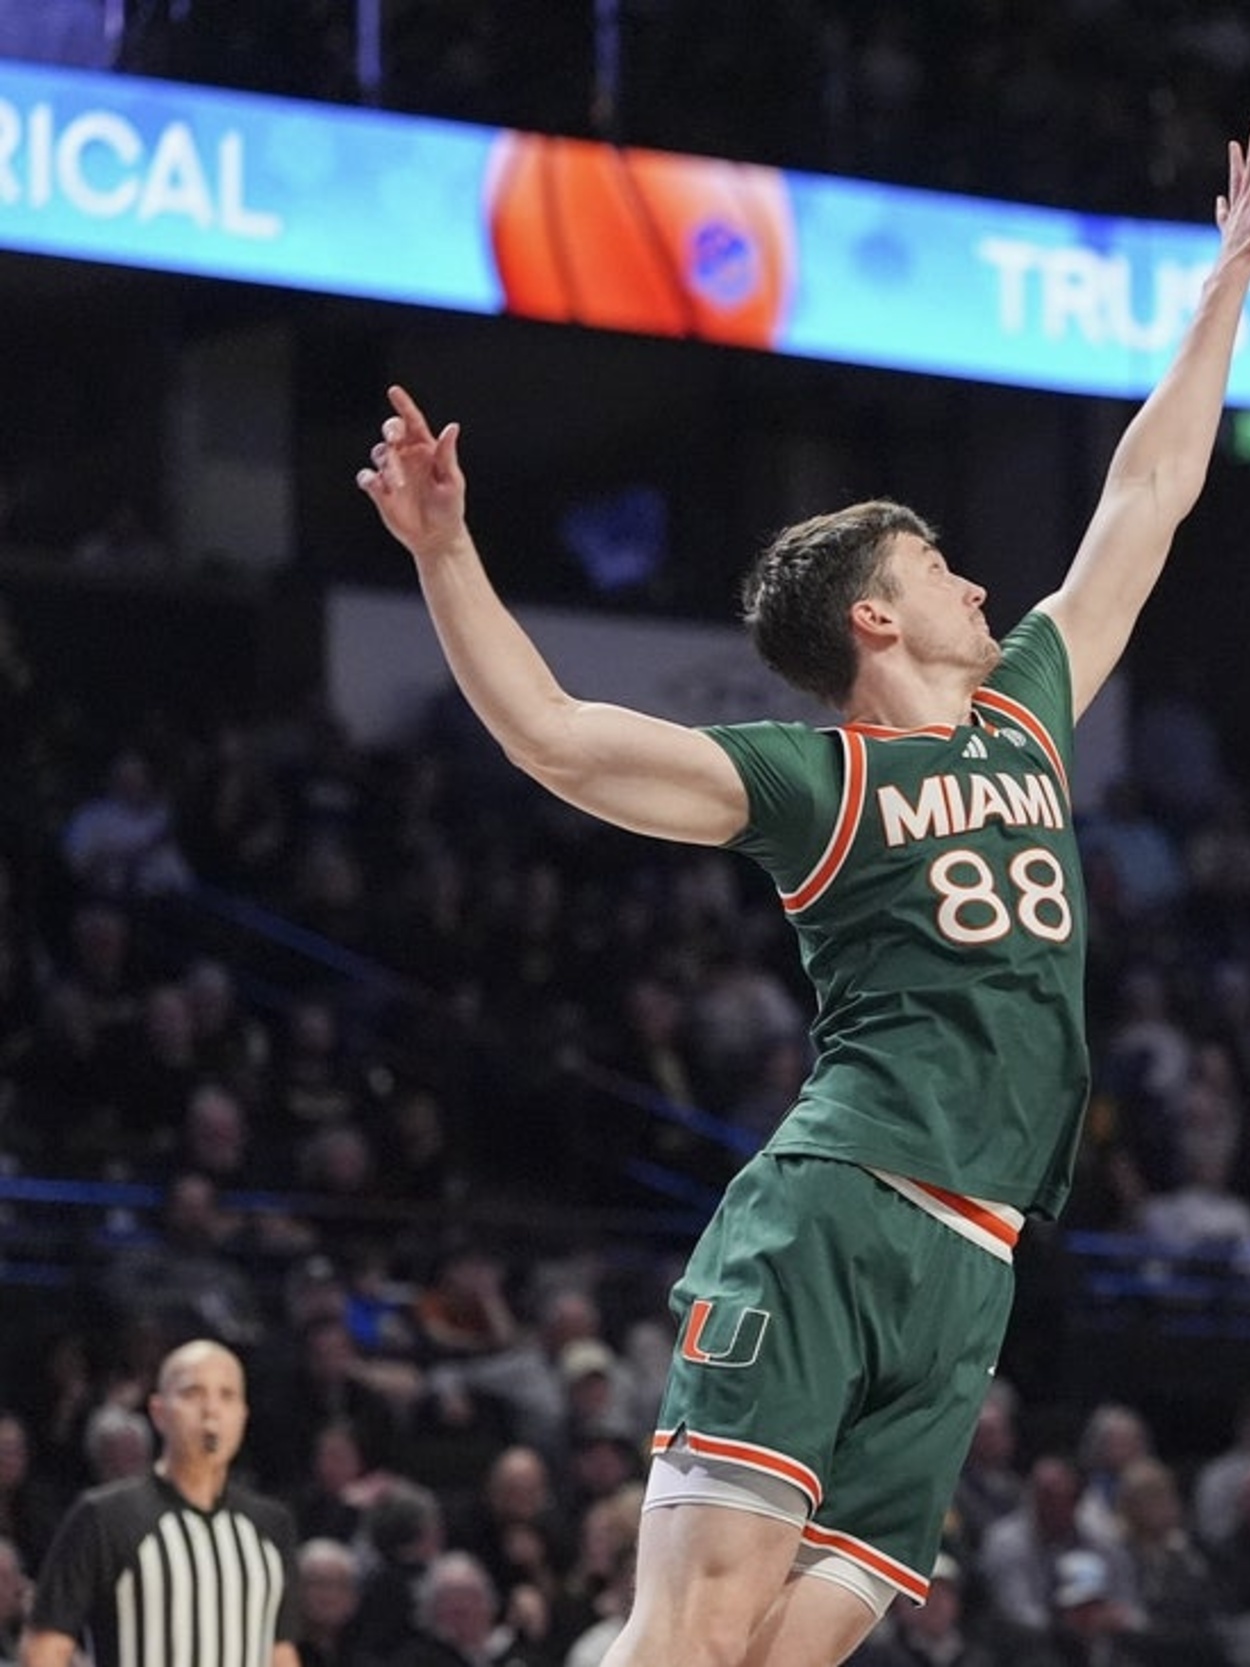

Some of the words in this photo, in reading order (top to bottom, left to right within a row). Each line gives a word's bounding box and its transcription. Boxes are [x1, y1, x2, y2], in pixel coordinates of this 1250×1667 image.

[876, 771, 1065, 848] MIAMI
[928, 848, 1073, 945] 88
[682, 1299, 770, 1369] U
